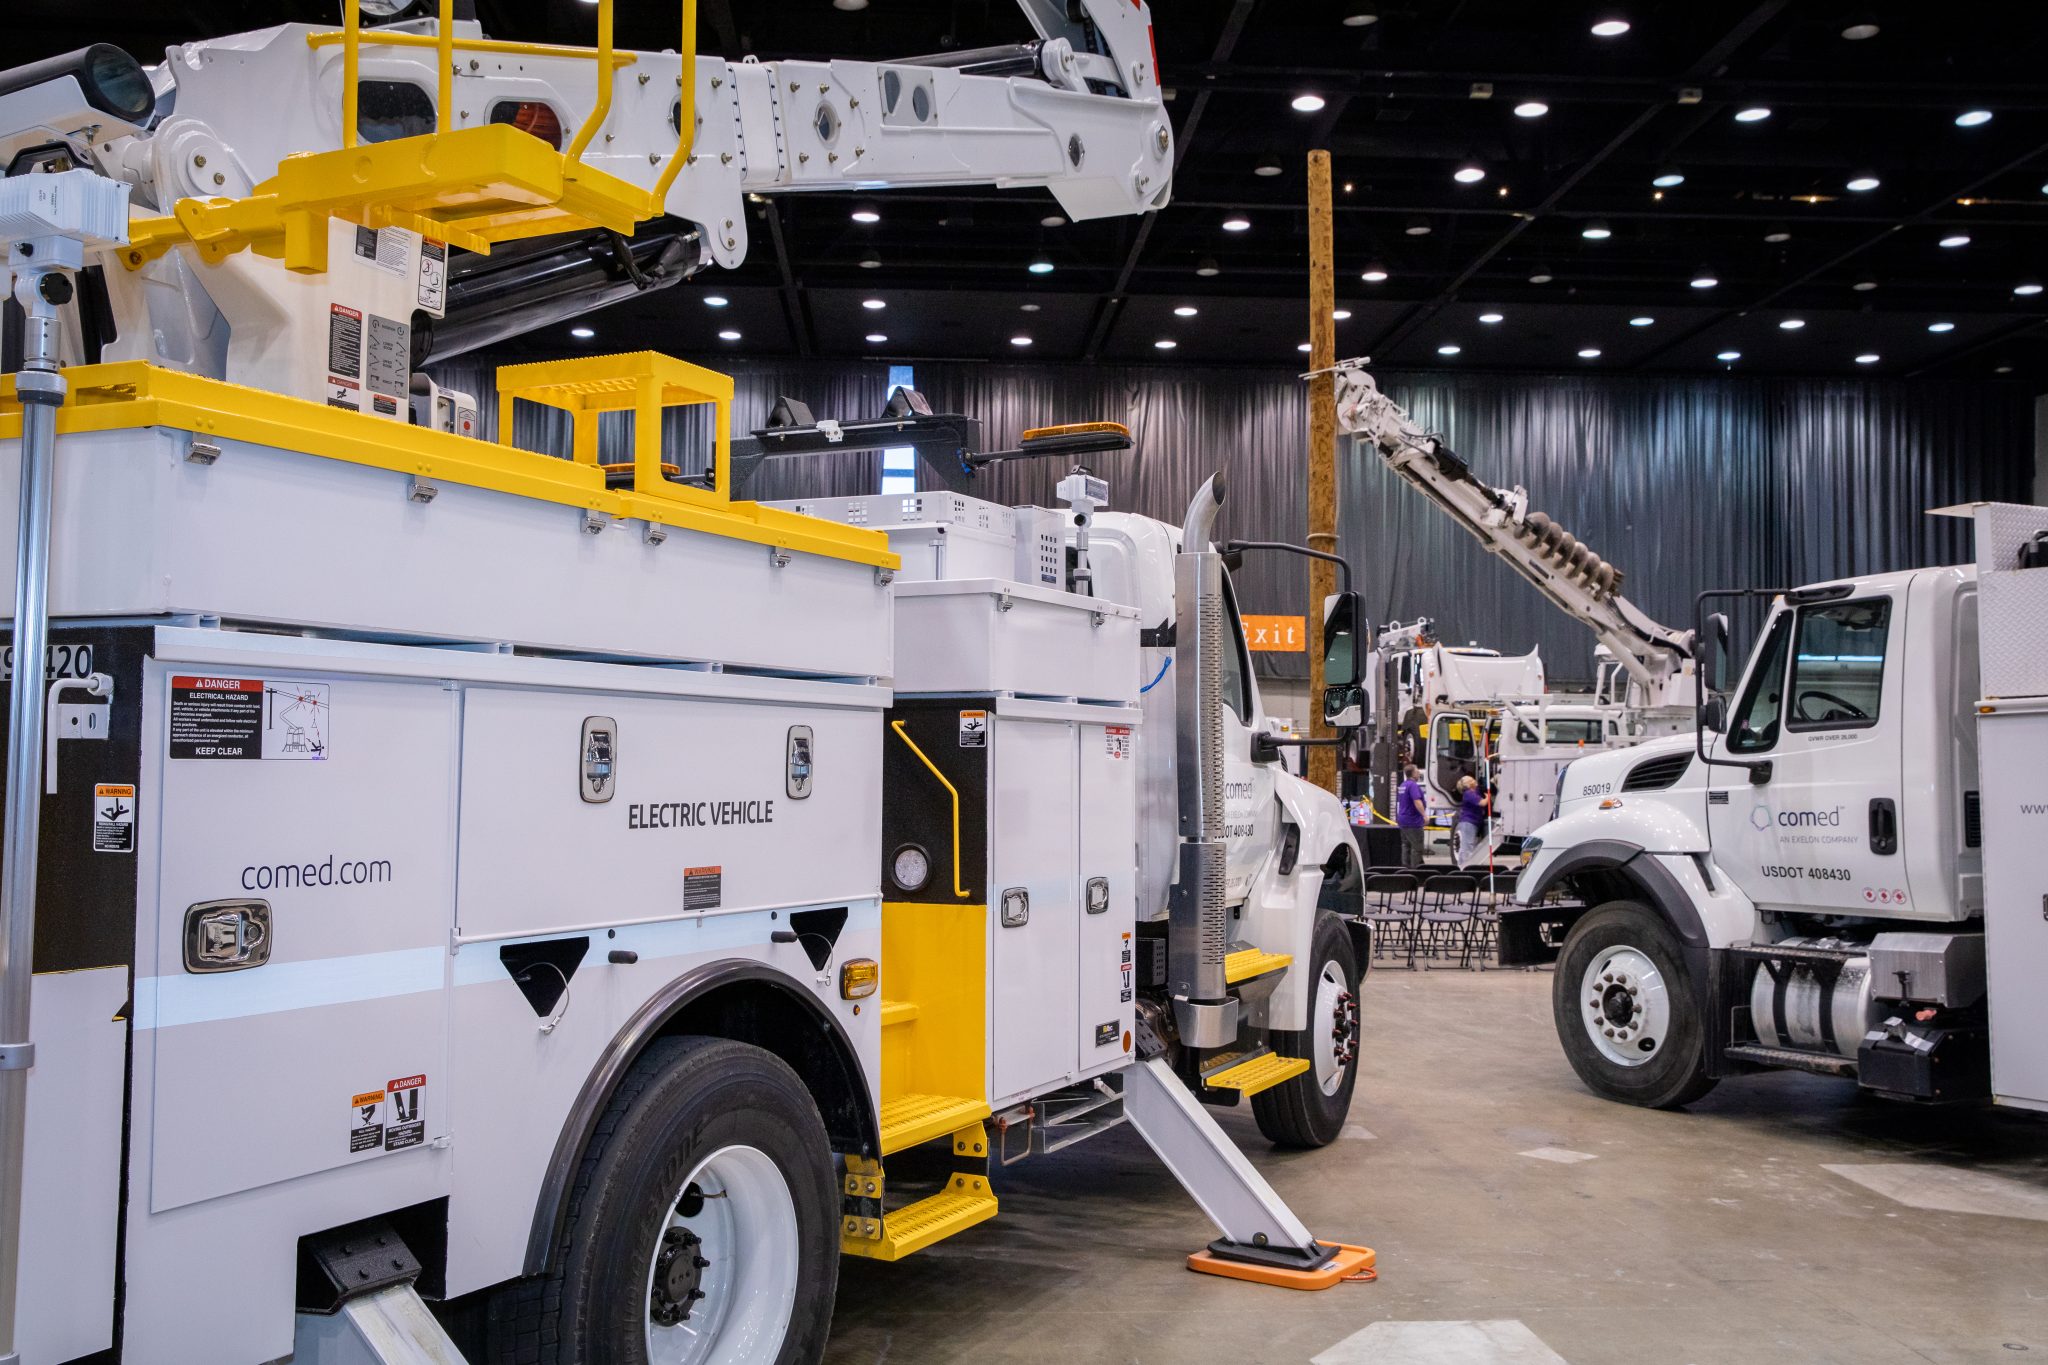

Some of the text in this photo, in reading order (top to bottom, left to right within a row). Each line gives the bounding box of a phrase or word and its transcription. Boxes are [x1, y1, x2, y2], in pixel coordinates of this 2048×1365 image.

[205, 680, 240, 689] DANGER
[189, 692, 249, 701] ELECTRICAL HAZARD
[196, 747, 243, 756] KEEP CLEAR
[1583, 782, 1610, 796] 850019
[2020, 804, 2048, 814] ww
[628, 800, 774, 829] ELECTRIC VEHICLE
[1778, 805, 1839, 826] comed
[1792, 836, 1820, 844] EXELON
[1821, 835, 1859, 844] COMPANY
[242, 854, 391, 890] comed.com
[1761, 865, 1851, 881] USDOT 408430
[400, 1077, 422, 1088] DANGER
[360, 1093, 383, 1103] WARNING
